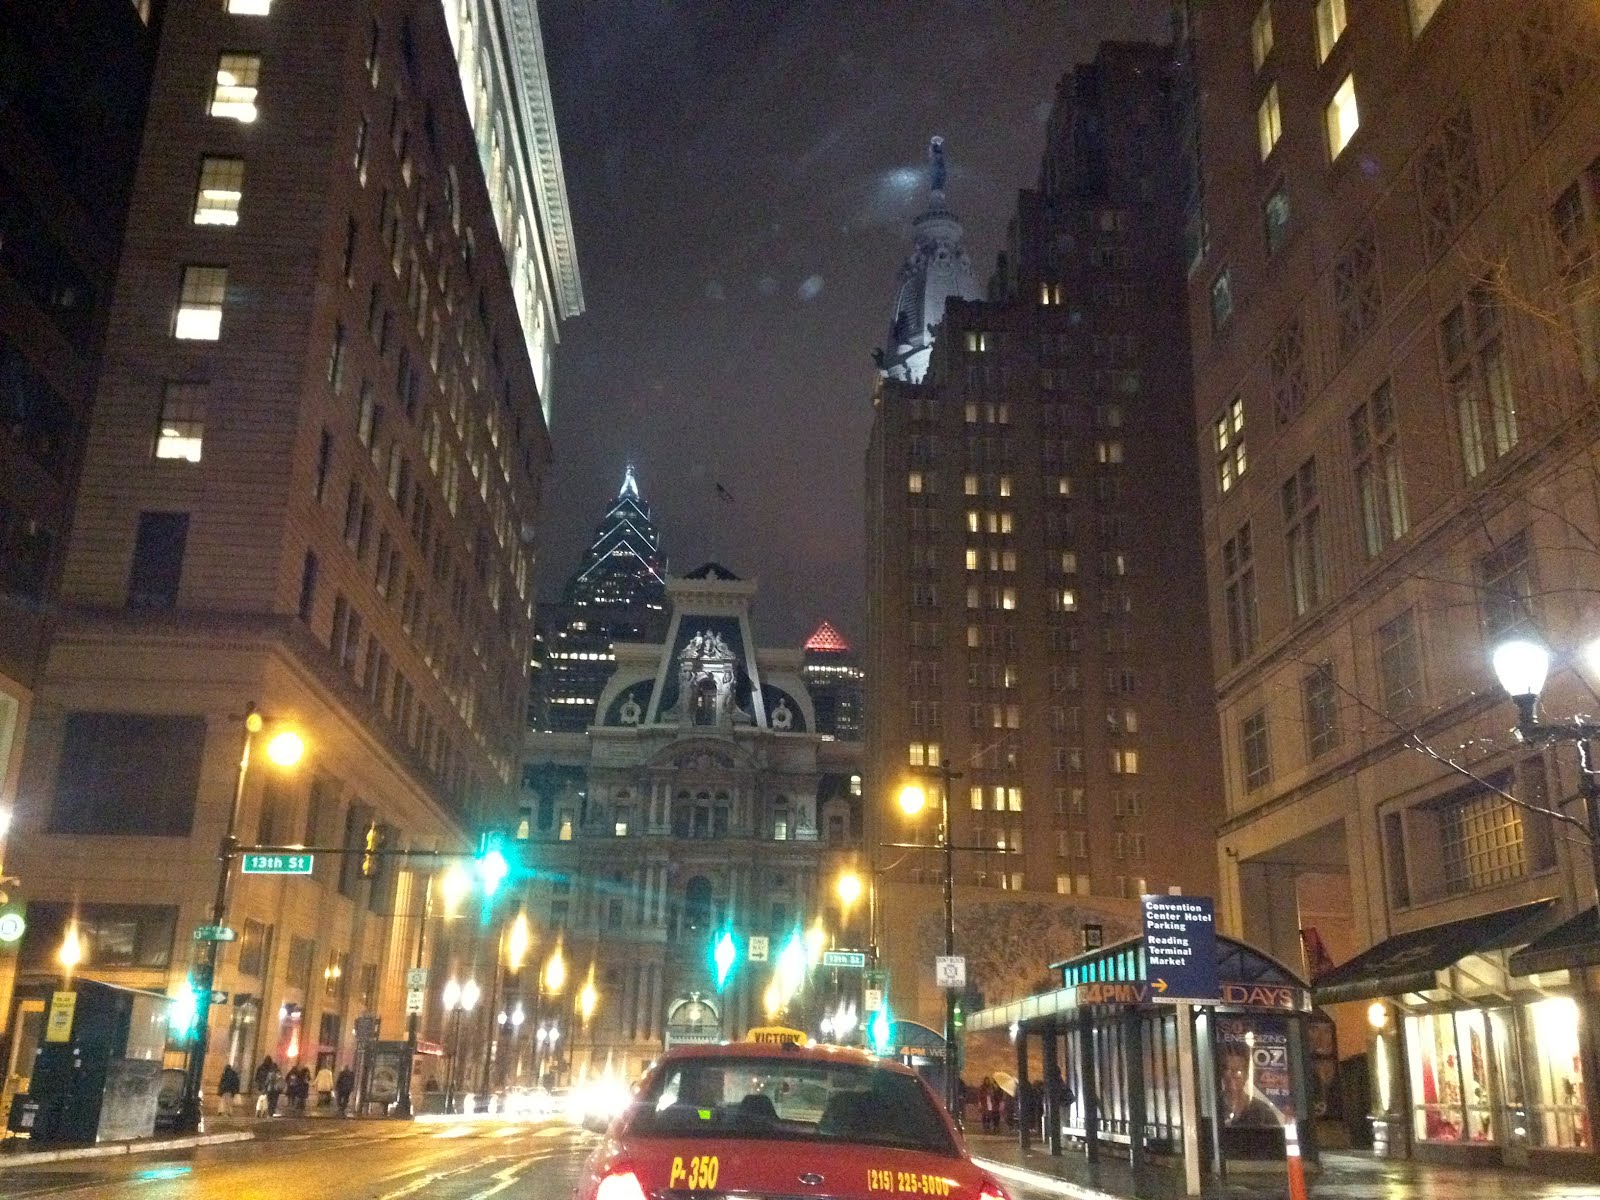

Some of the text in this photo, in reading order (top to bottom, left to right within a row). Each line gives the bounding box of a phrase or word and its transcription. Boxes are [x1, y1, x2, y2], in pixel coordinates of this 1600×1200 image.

[252, 856, 304, 868] 13th St
[1145, 902, 1202, 912] Convention
[1146, 912, 1212, 921] Center Hotel
[1147, 921, 1186, 931] Parking
[1148, 936, 1189, 946] Reading
[1148, 946, 1192, 955] Terminal
[850, 956, 860, 964] St
[1150, 957, 1186, 966] Market
[755, 1032, 800, 1043] VICTORY
[1254, 1049, 1284, 1067] OZ
[670, 1156, 719, 1190] P-350
[867, 1169, 950, 1196] (215) 225-5000
